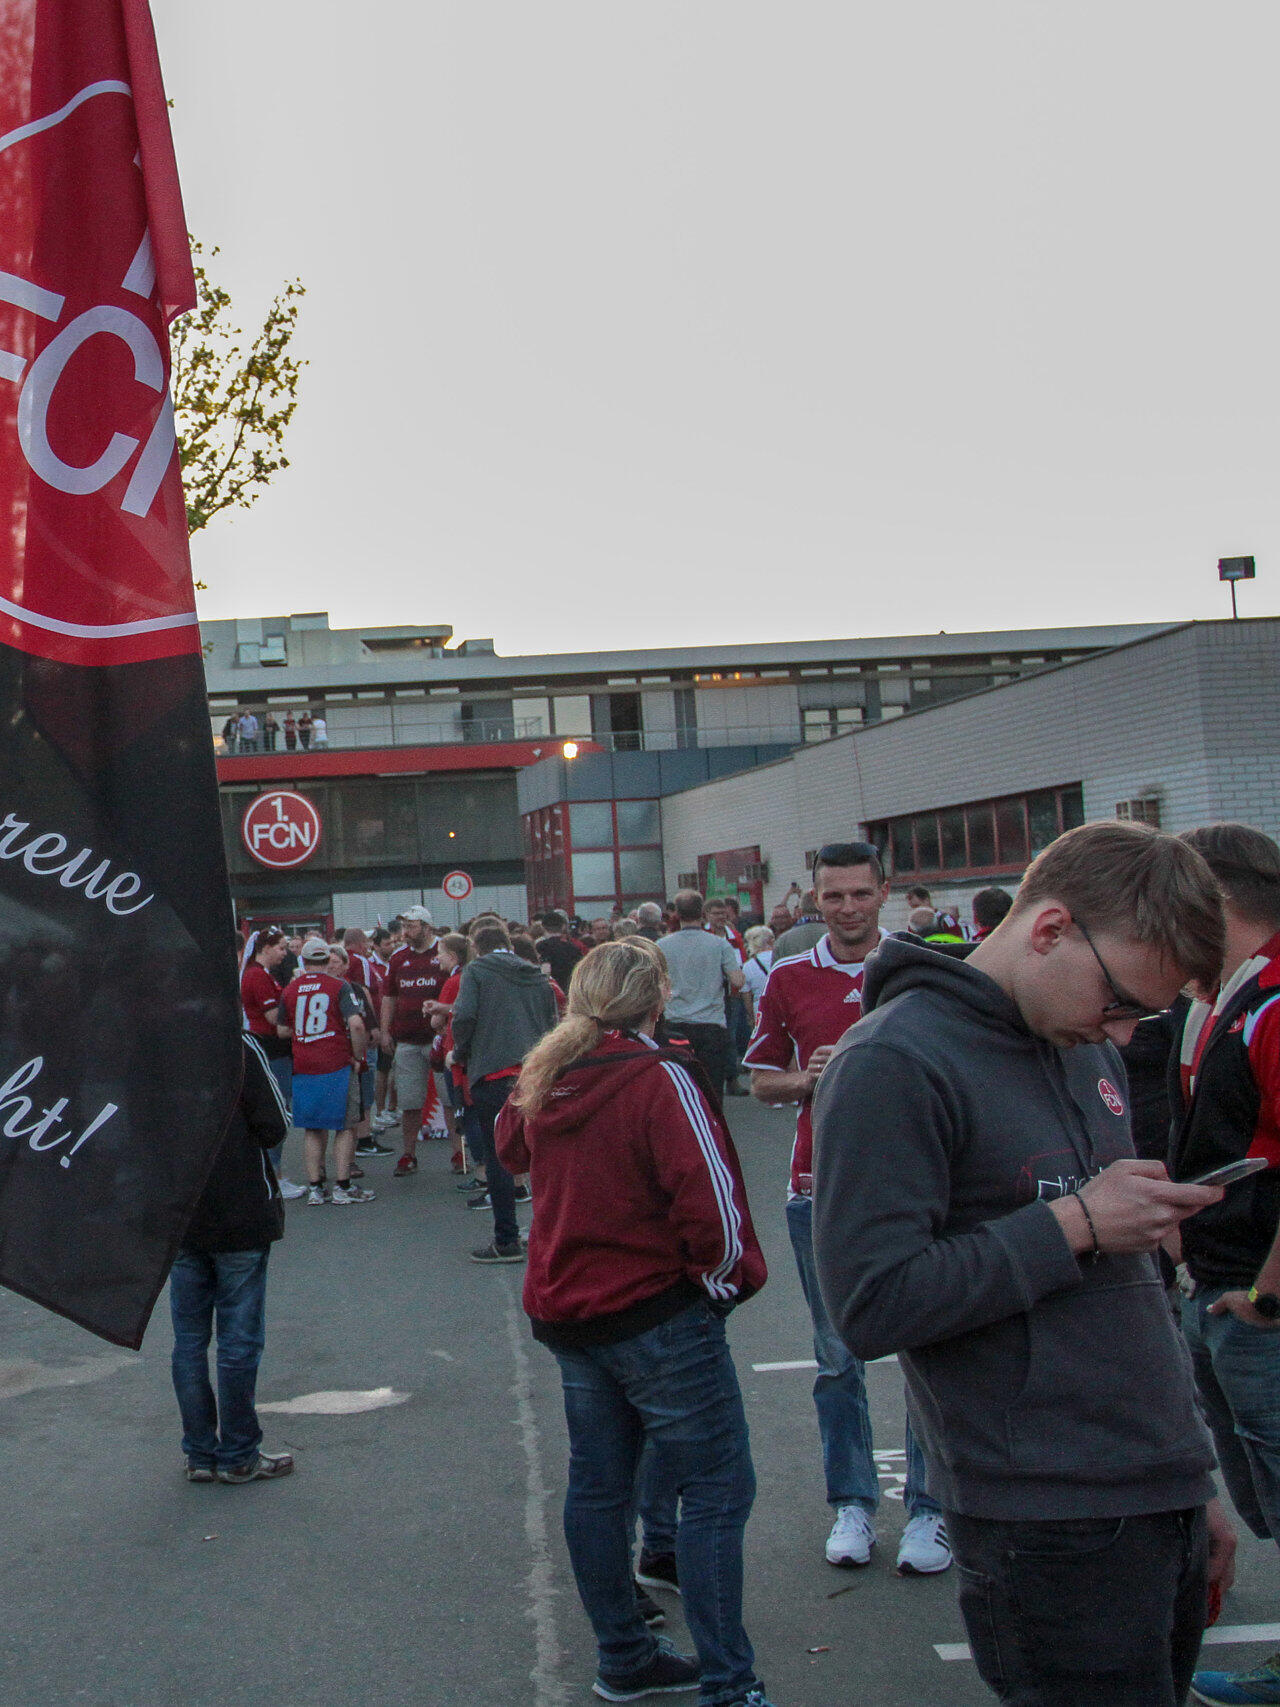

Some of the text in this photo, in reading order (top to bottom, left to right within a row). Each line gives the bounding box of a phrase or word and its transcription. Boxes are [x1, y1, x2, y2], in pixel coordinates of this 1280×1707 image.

[271, 797, 289, 821] 1.
[253, 822, 310, 849] FCN
[400, 977, 437, 987] Der Club
[295, 993, 330, 1036] 18
